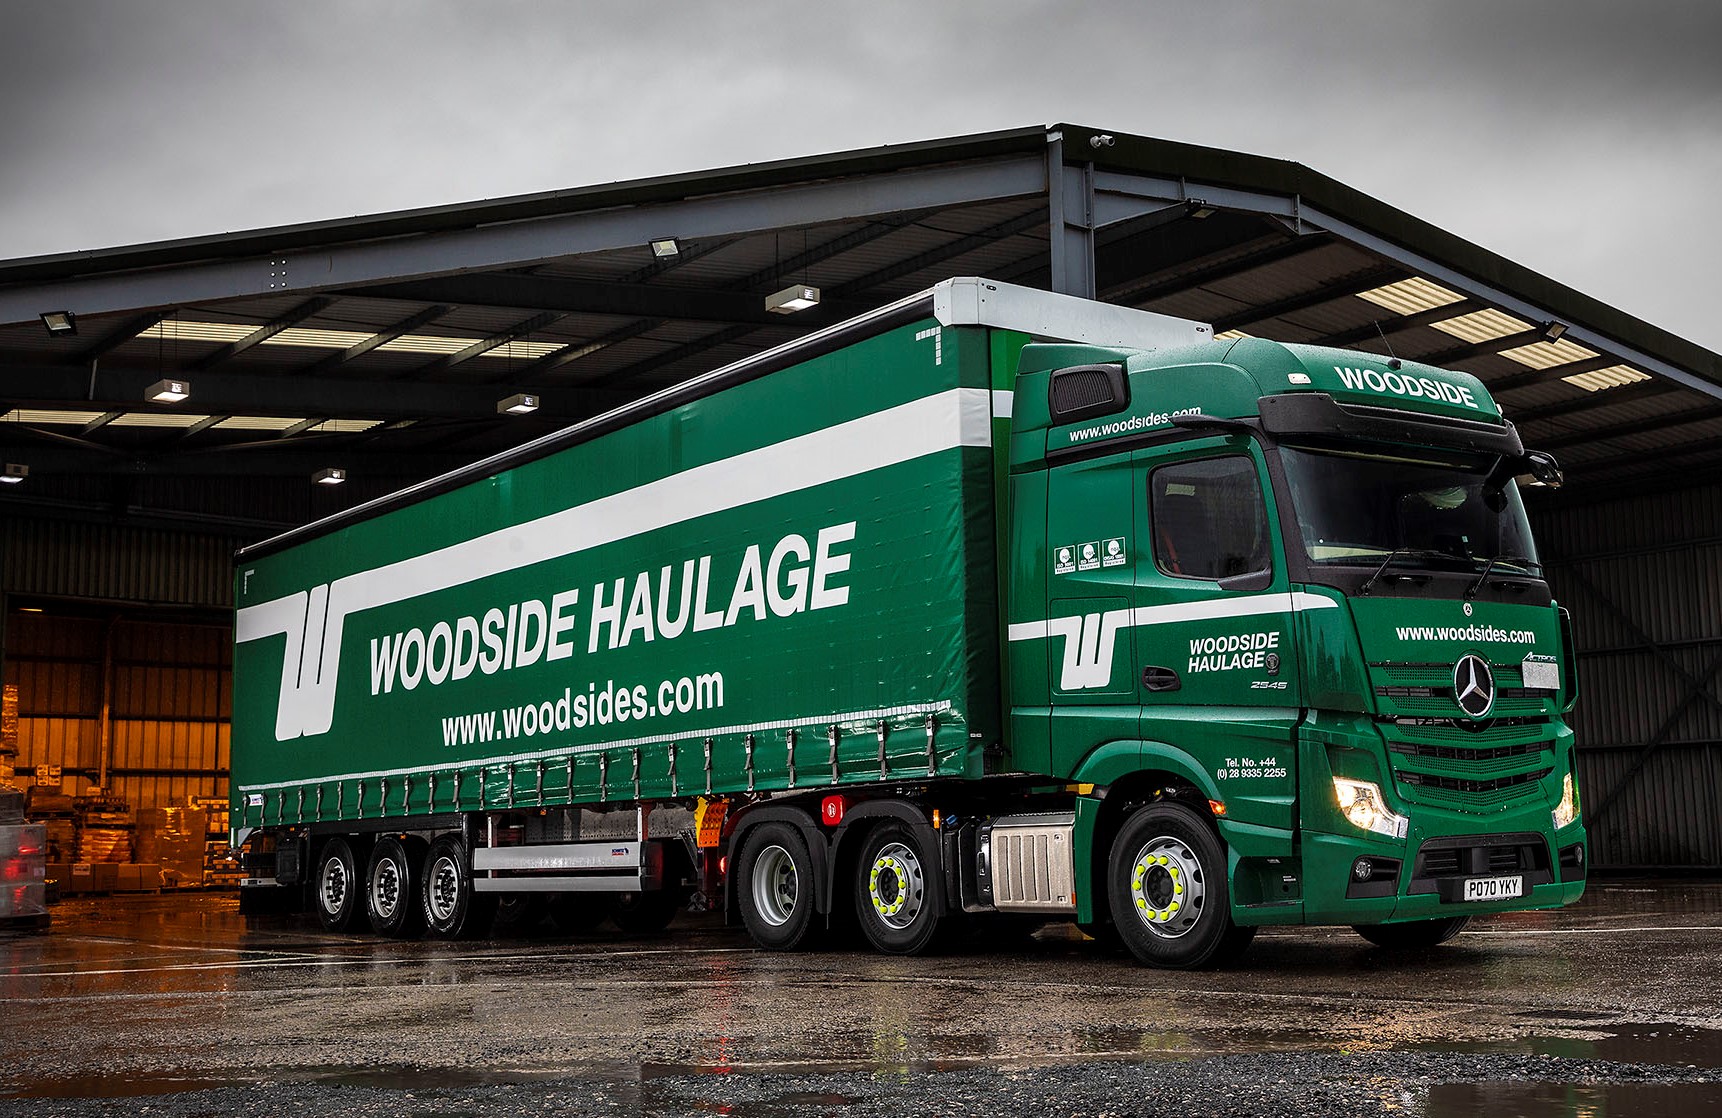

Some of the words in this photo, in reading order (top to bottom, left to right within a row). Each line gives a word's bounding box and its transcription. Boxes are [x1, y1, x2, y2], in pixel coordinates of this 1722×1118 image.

[1334, 366, 1479, 409] WOODSIDE
[371, 587, 580, 696] WOODSIDE
[587, 520, 857, 654] HAULAGE
[1189, 631, 1280, 656] WOODSIDE
[1396, 624, 1536, 644] www.woodsides.com
[1187, 651, 1266, 674] HAULAGE
[1250, 681, 1288, 690] 2545
[441, 671, 724, 747] www.woodsides.com
[1225, 757, 1240, 767] Tel.
[1241, 757, 1257, 767] No.
[1259, 756, 1277, 767] +44
[1217, 768, 1228, 780] (0)
[1229, 768, 1240, 778] 28
[1241, 768, 1262, 778] 9335
[1263, 767, 1287, 778] 2255
[1499, 878, 1518, 895] YKY
